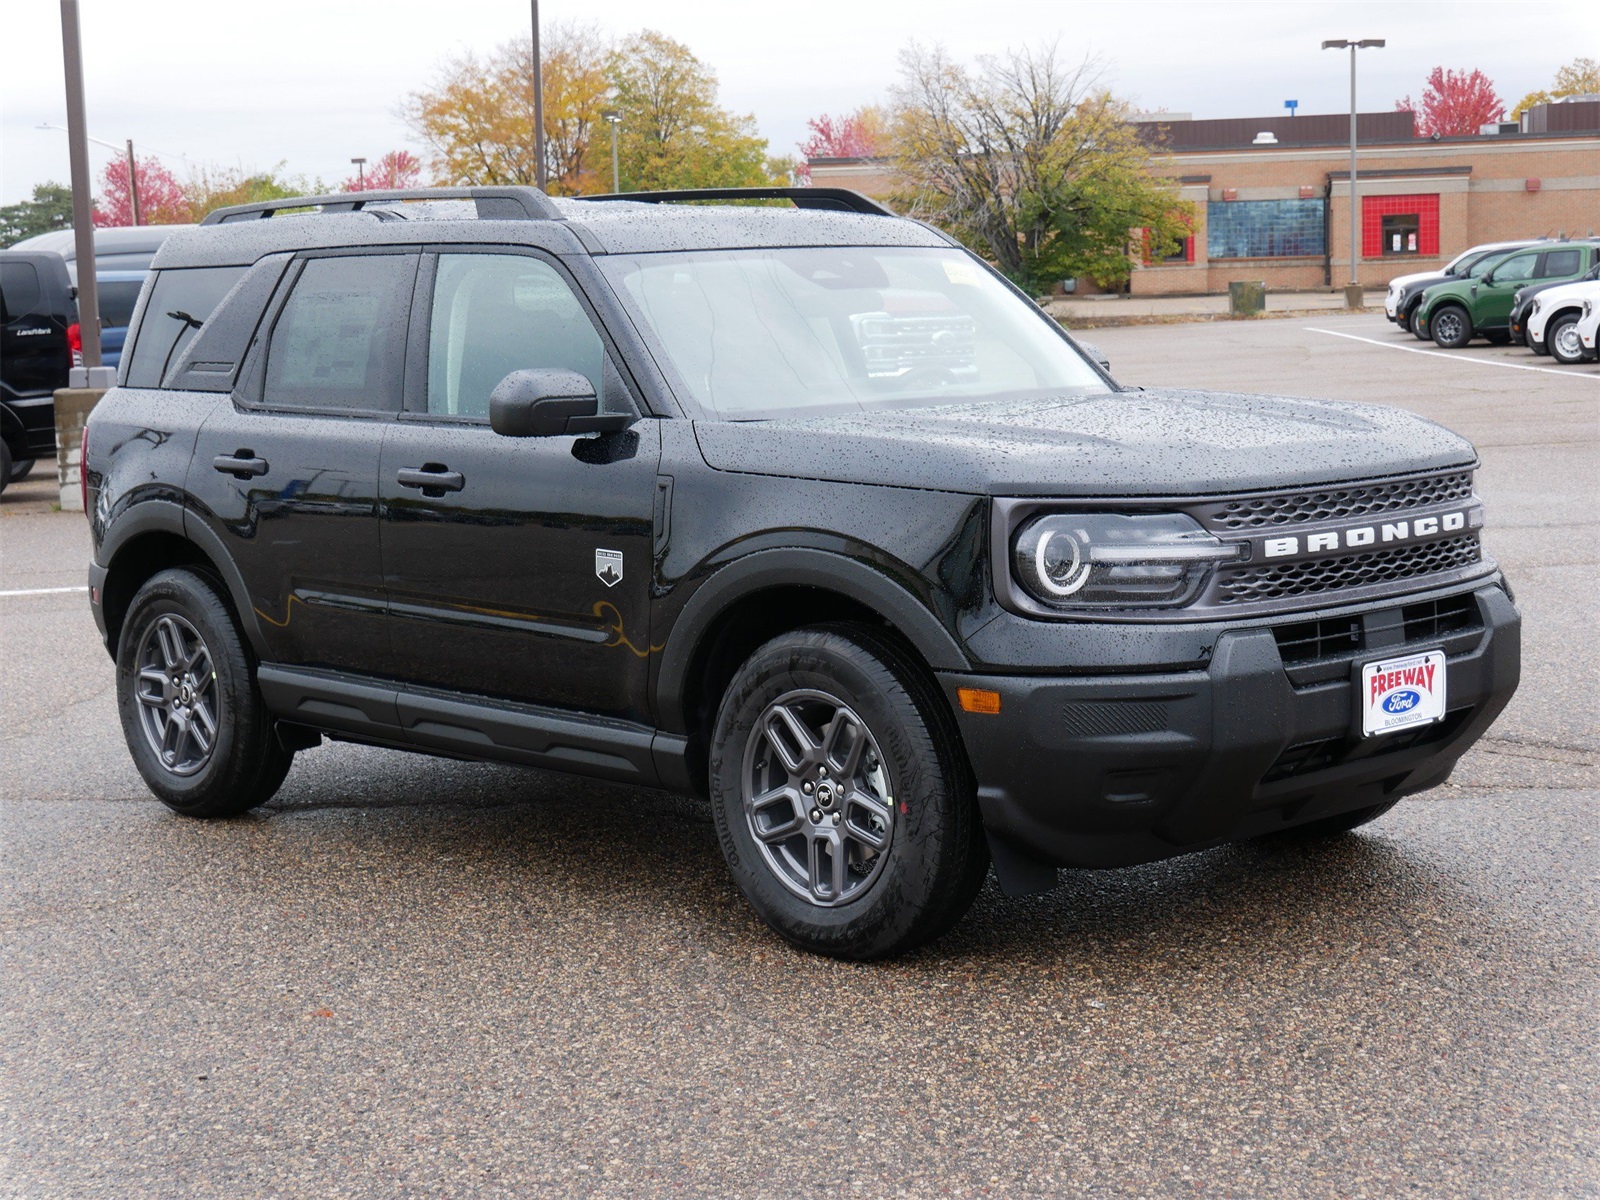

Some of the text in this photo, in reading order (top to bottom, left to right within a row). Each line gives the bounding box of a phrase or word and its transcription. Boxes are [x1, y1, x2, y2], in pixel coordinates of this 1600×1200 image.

[17, 328, 52, 336] LandMark
[1264, 512, 1464, 558] BRONCO
[1371, 664, 1436, 710] FREEWAY
[1388, 692, 1414, 712] Ford
[1385, 712, 1423, 727] BLOOMINGTON
